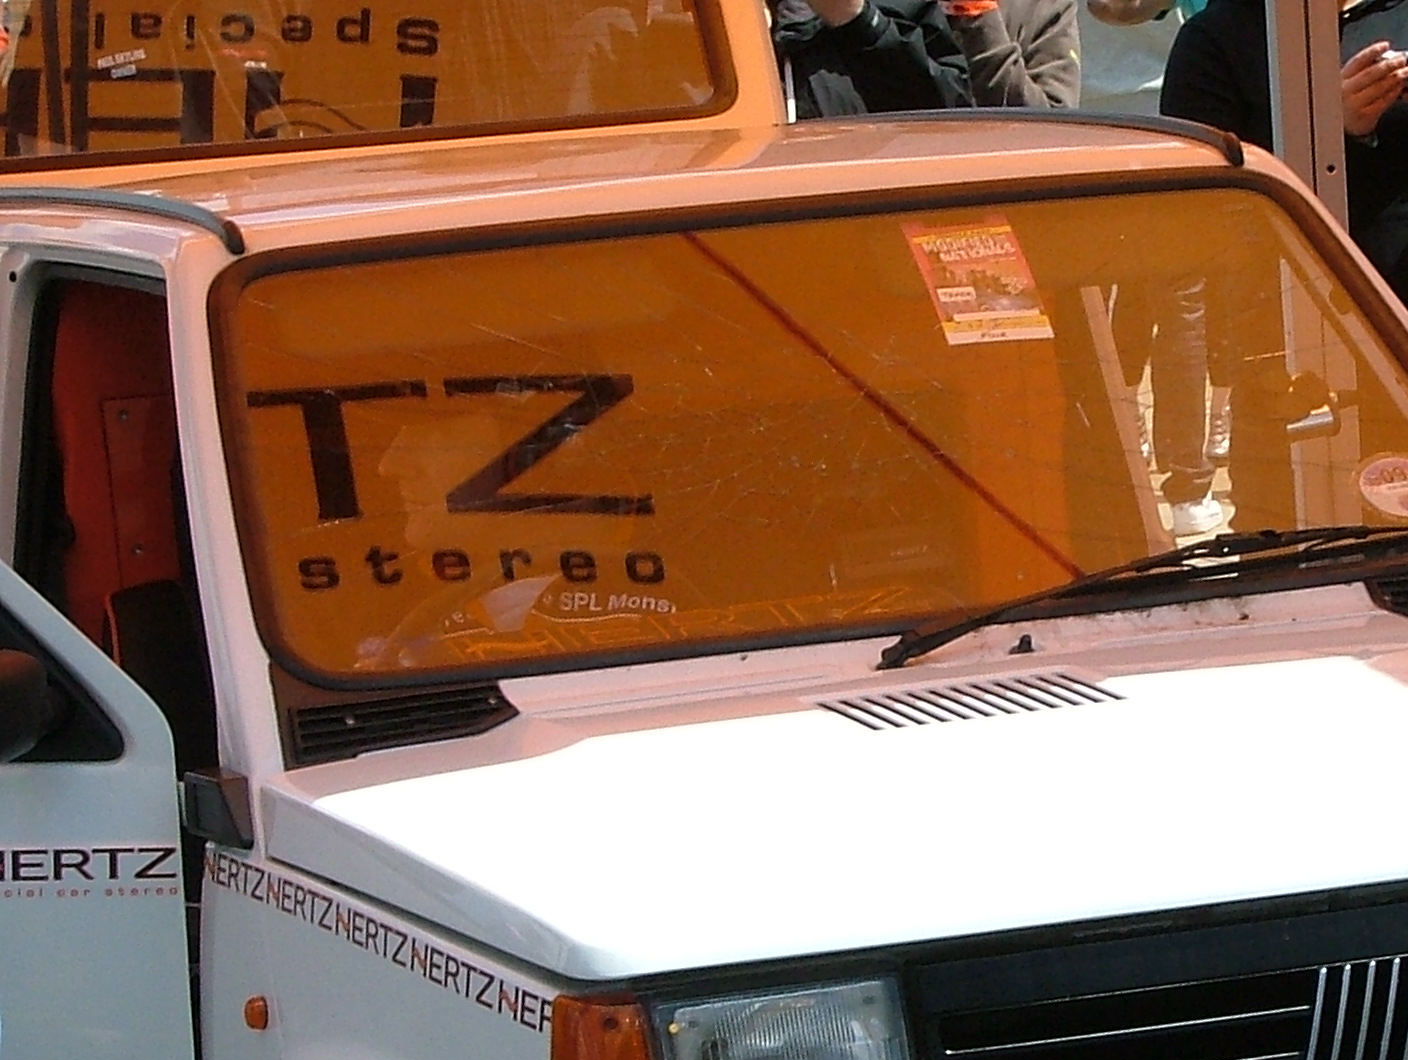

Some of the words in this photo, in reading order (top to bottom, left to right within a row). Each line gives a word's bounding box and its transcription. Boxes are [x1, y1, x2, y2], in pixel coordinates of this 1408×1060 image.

[297, 545, 667, 591] stereo
[558, 591, 602, 613] SPL
[56, 887, 92, 898] car
[104, 885, 179, 898] stereo
[266, 872, 334, 932] HERTZ
[335, 902, 411, 969] HERTZ
[411, 936, 496, 1011] HERTZ
